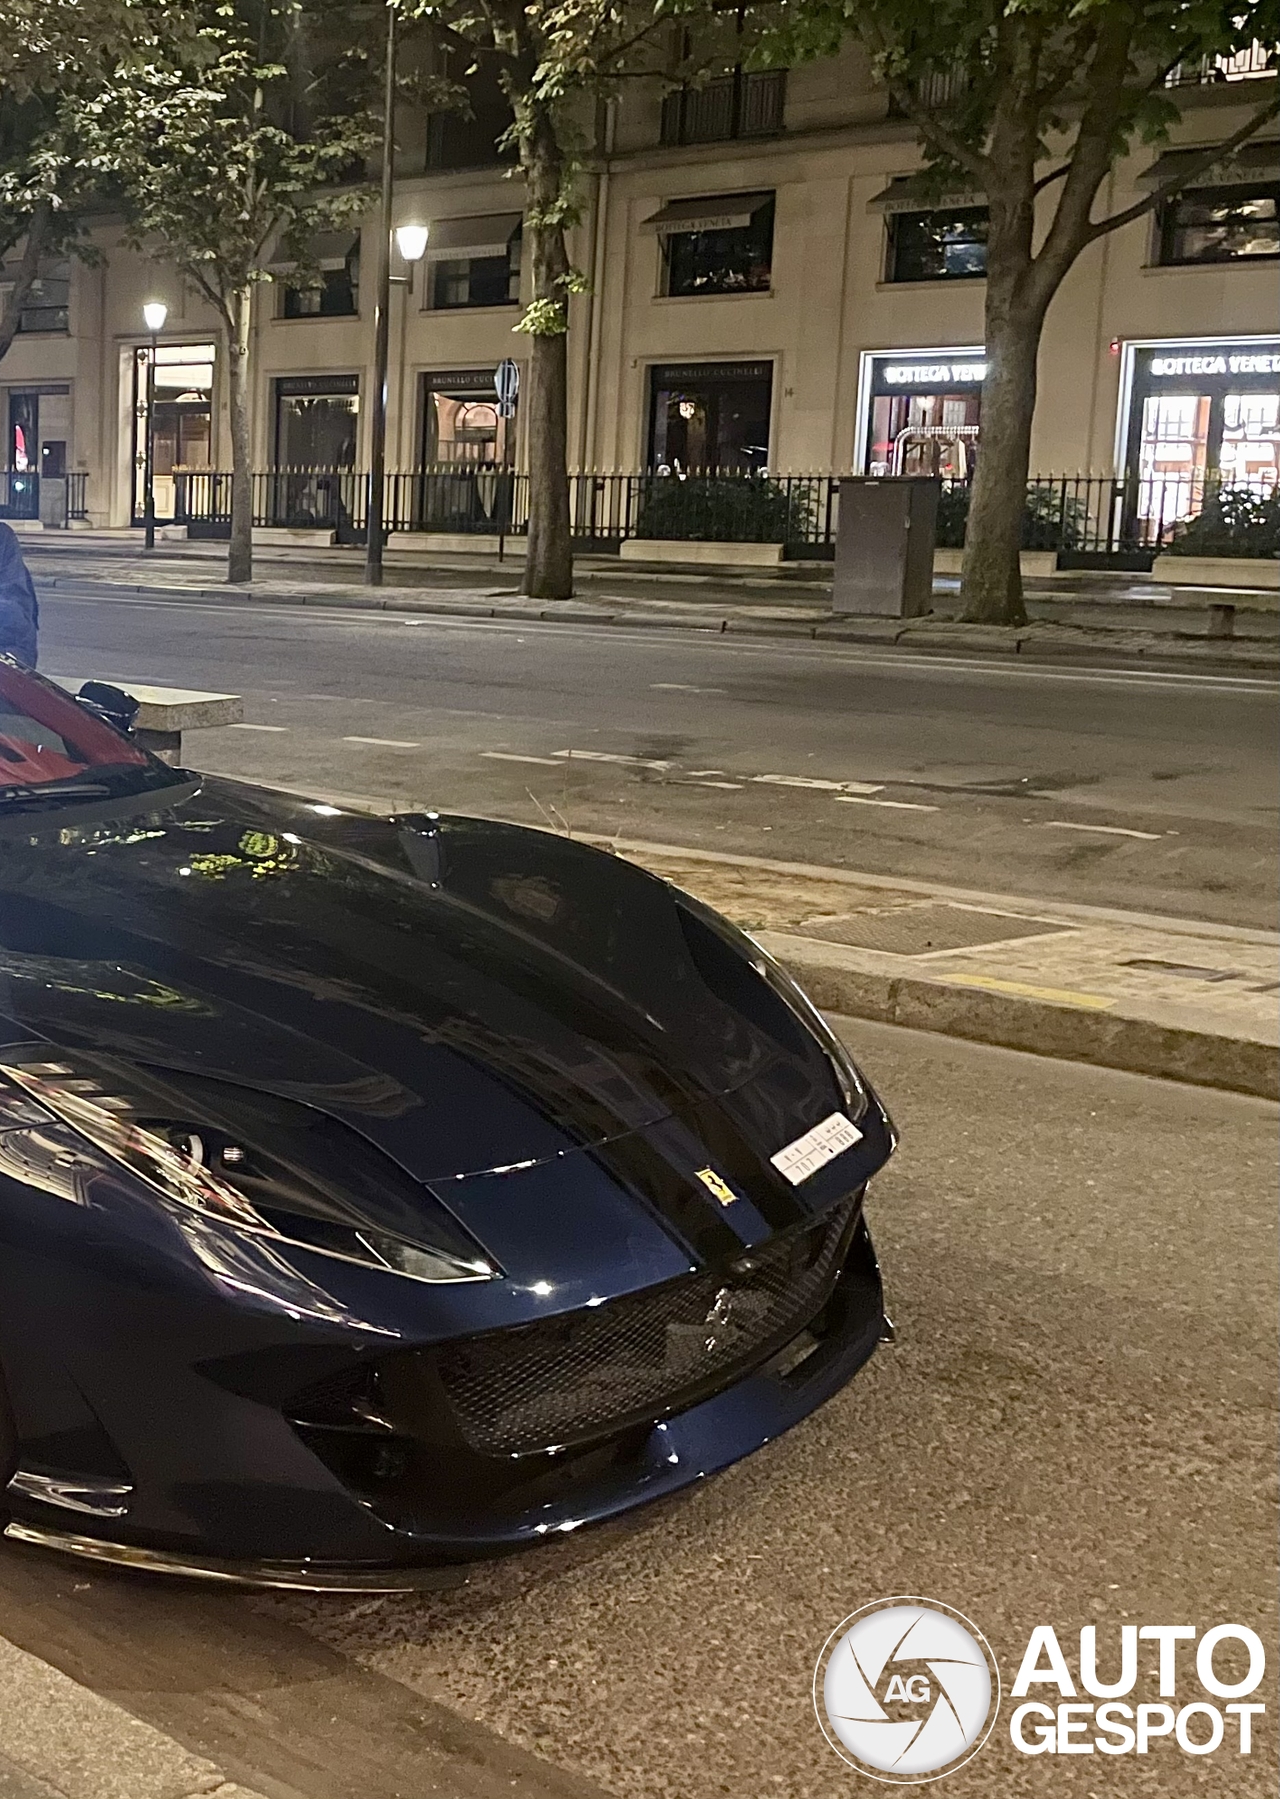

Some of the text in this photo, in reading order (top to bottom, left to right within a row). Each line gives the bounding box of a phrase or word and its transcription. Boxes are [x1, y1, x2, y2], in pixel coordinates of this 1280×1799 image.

[885, 363, 987, 383] BOTTEGA VEN
[1151, 354, 1280, 375] BOTTEGA VENET
[432, 376, 471, 385] BRUNELLO
[795, 1157, 815, 1175] 707
